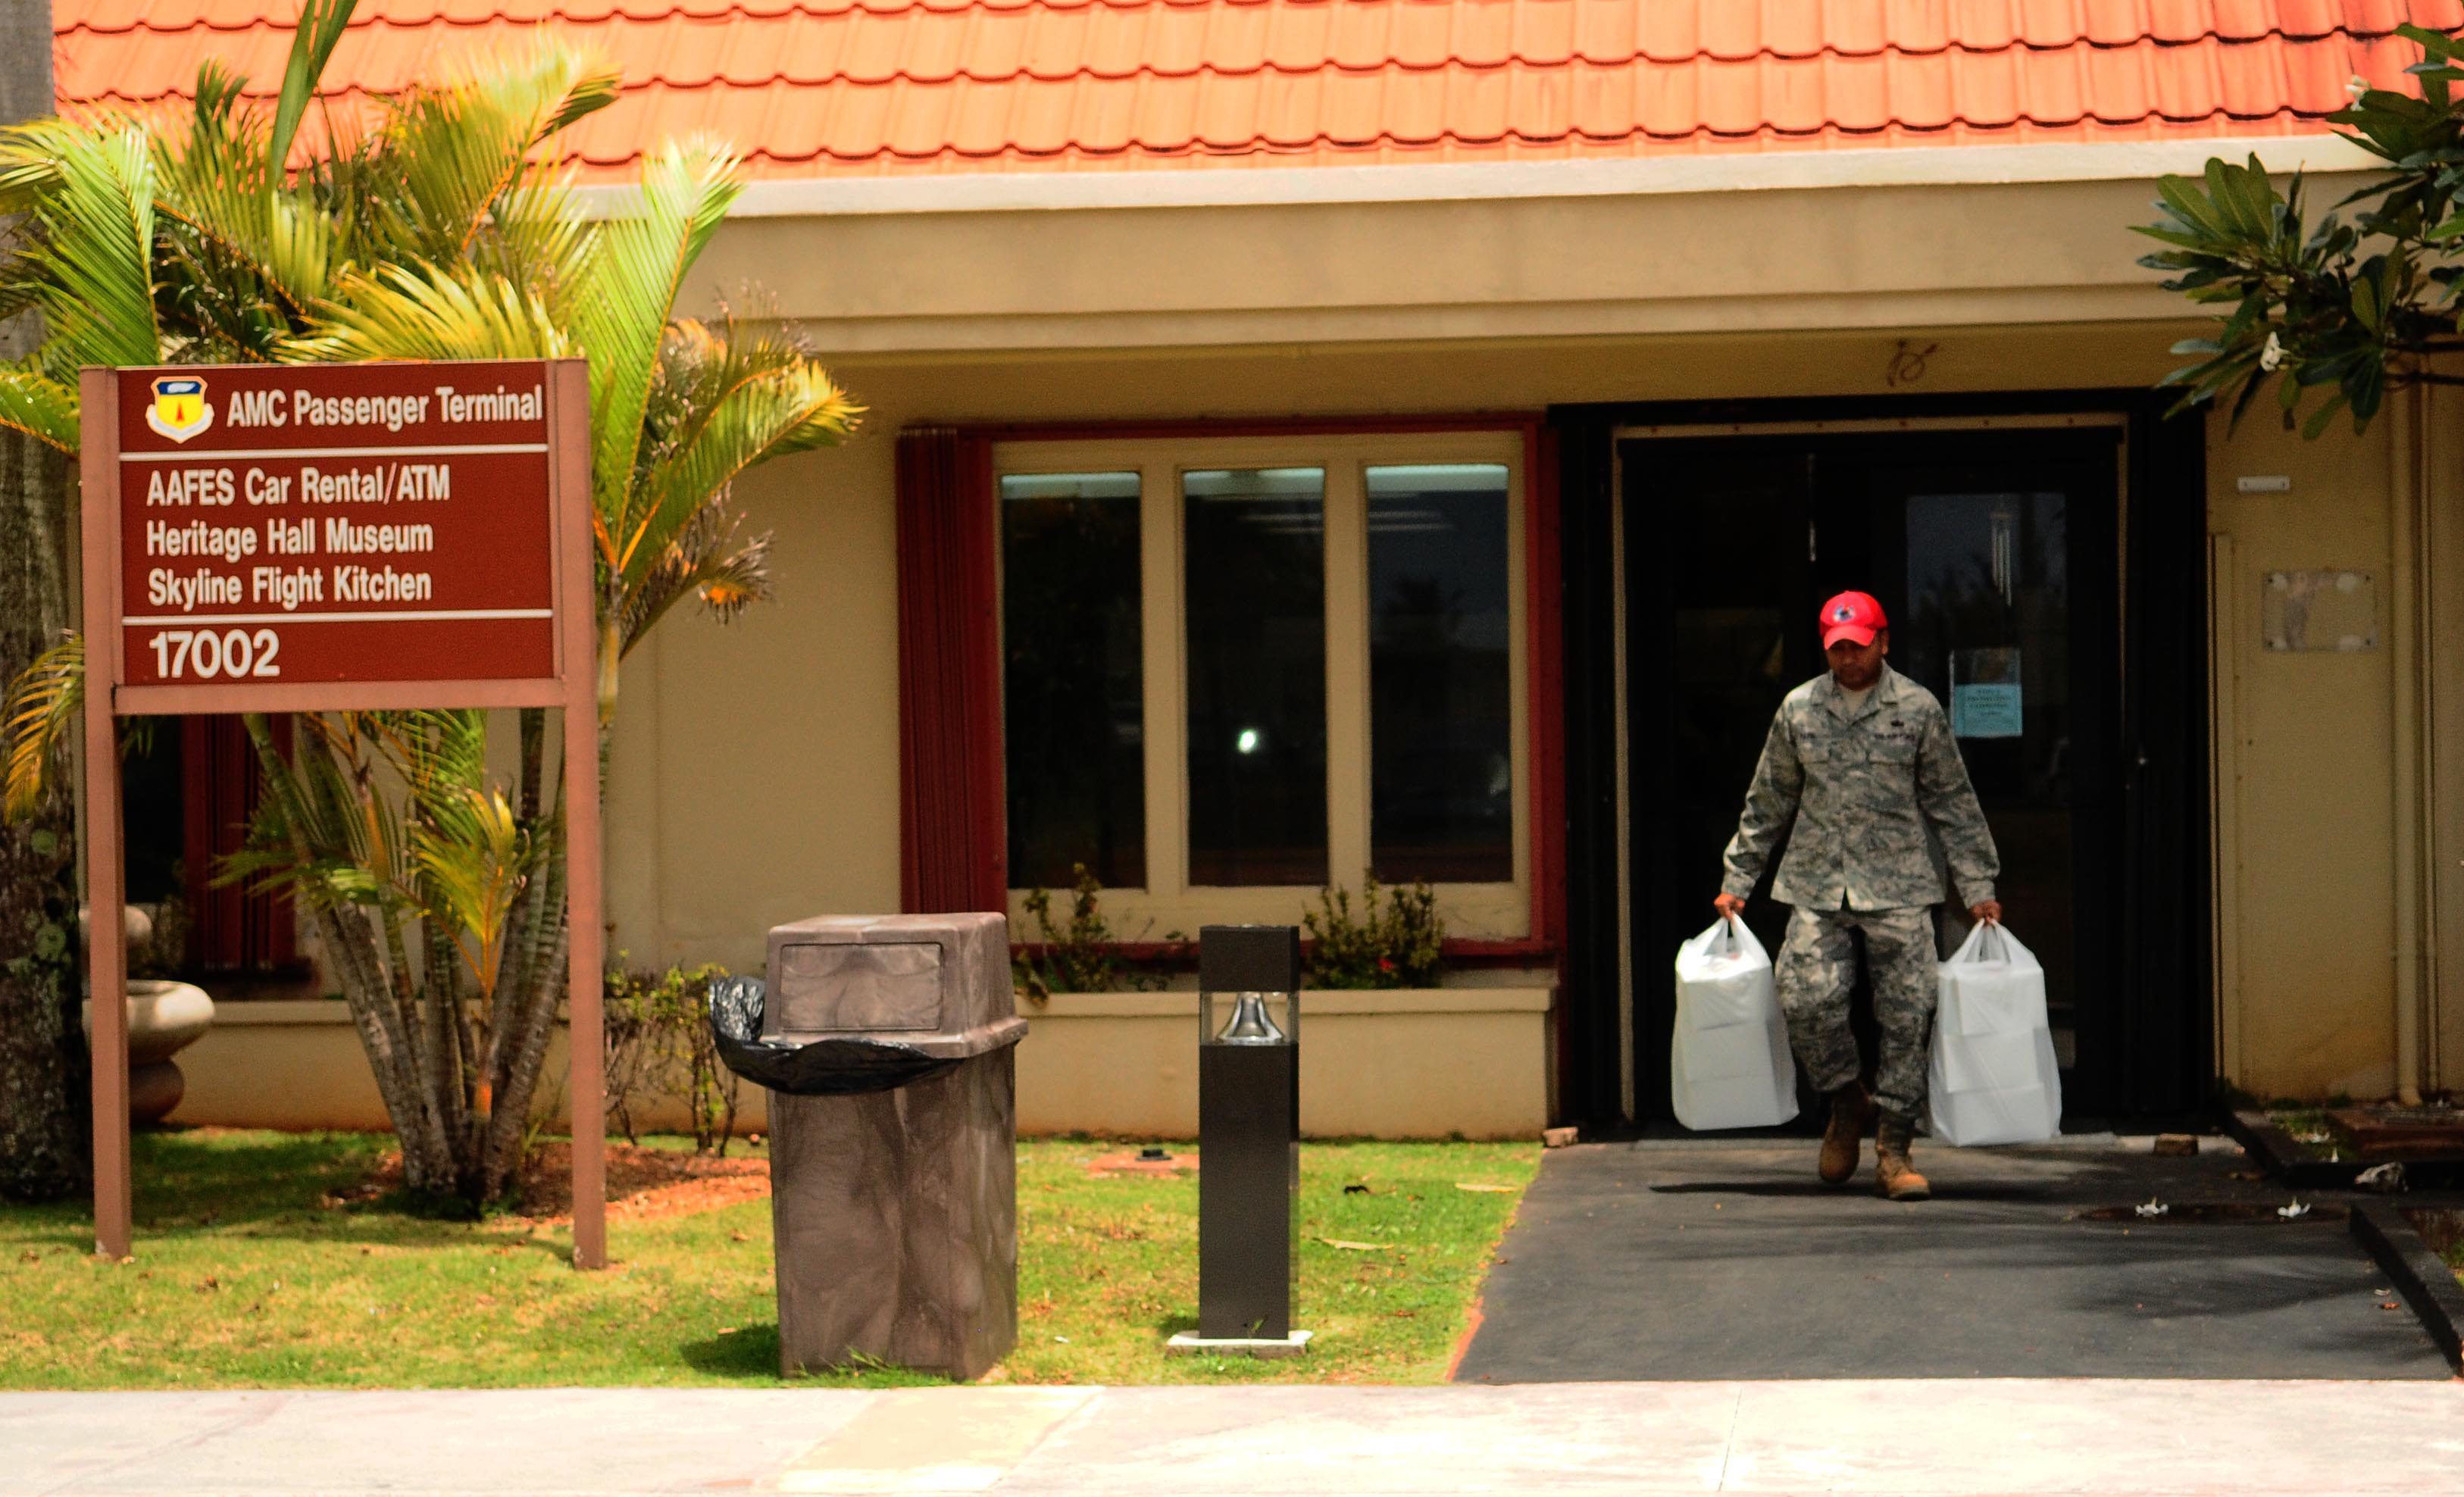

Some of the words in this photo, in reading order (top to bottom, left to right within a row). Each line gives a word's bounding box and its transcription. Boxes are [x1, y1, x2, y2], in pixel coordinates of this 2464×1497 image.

[227, 389, 288, 427] AMC
[293, 389, 430, 433] Passenger
[434, 383, 543, 423] Terminal
[146, 467, 236, 507] AAFES
[244, 467, 292, 505] Car
[301, 461, 450, 505] Rental/ATM
[146, 519, 258, 564] Heritage
[267, 517, 316, 555] Hall
[325, 517, 433, 554] Museum
[148, 567, 243, 612] Skyline
[252, 566, 324, 611] Flight
[333, 564, 432, 602] Kitchen
[149, 628, 280, 679] 17002
